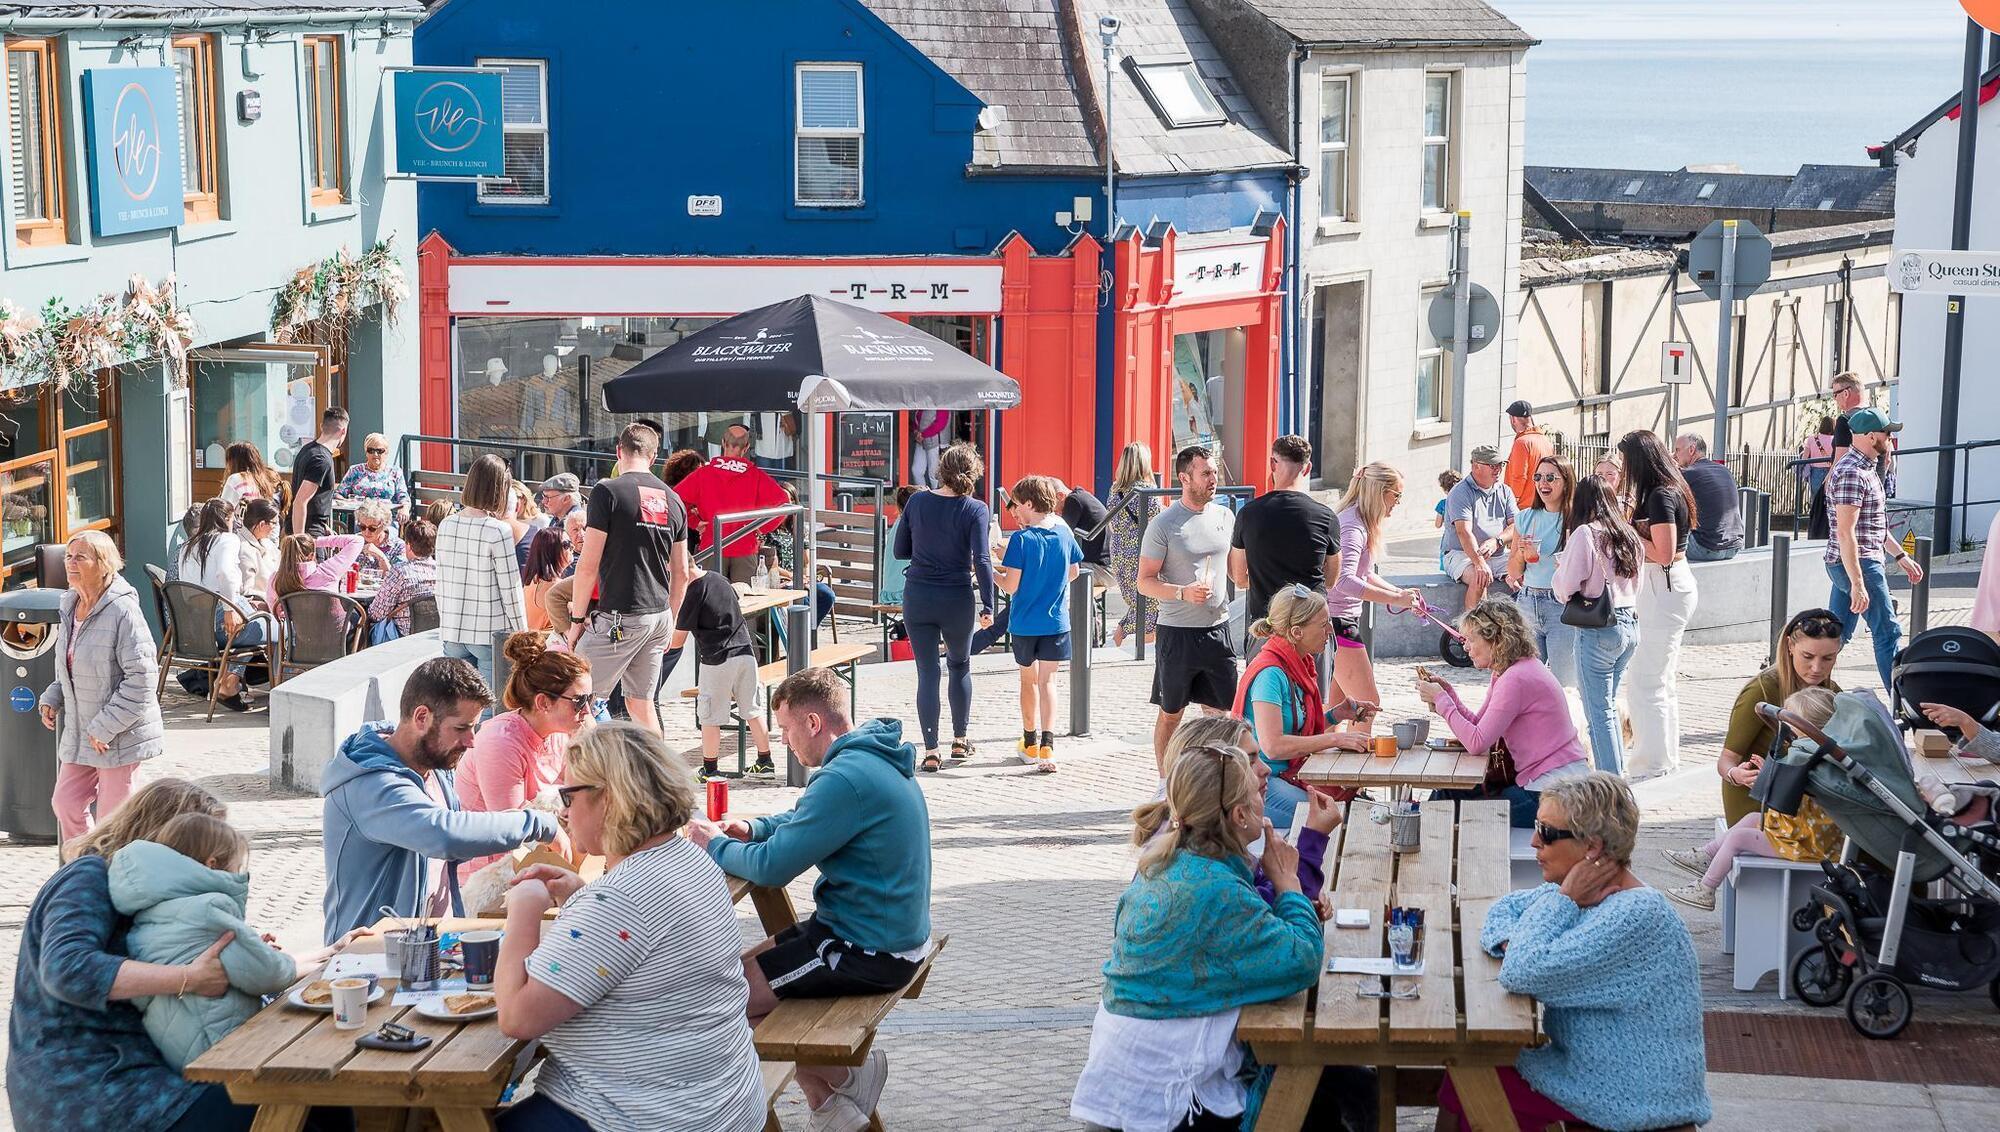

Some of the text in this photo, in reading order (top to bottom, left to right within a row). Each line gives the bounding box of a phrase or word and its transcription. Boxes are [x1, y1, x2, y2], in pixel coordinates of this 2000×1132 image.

[430, 160, 458, 168] BRUNCH
[1928, 262, 1979, 280] Queen
[1950, 303, 1956, 311] 2
[691, 342, 793, 356] BLACKWATER
[842, 344, 935, 356] BLACKWATER
[850, 449, 882, 457] ARRIVALS
